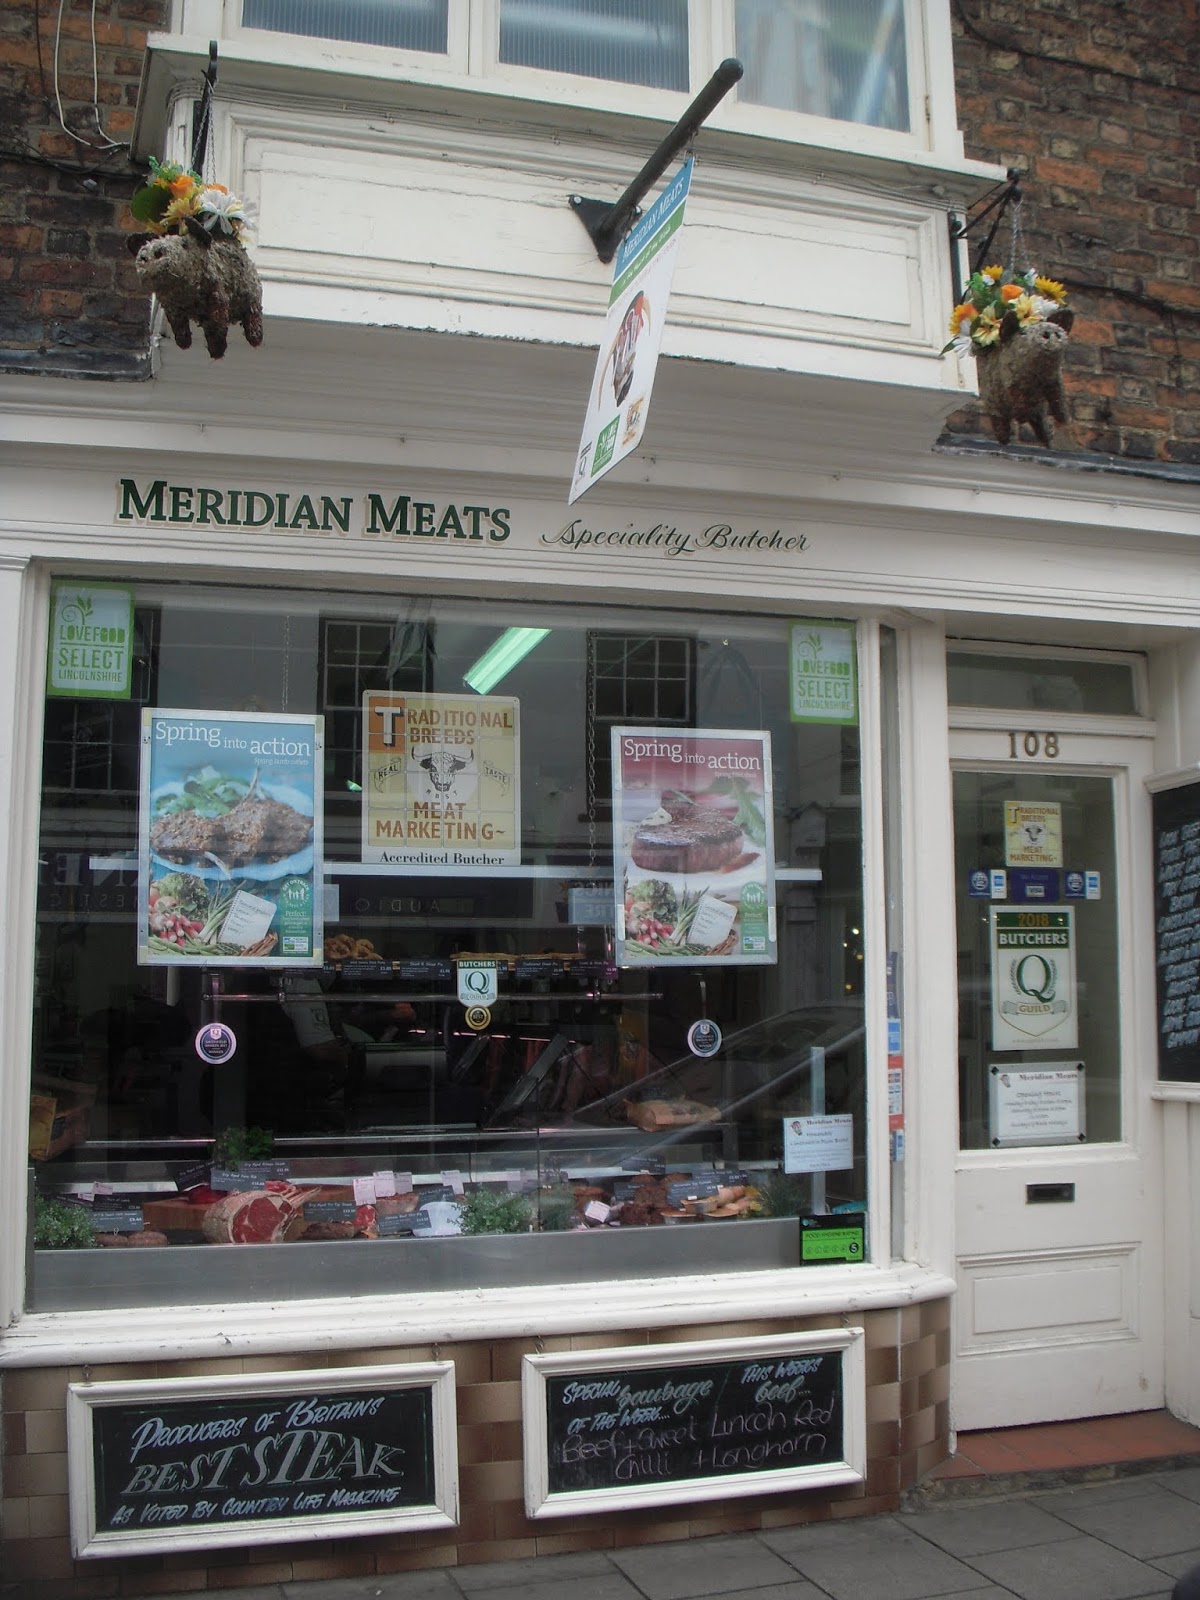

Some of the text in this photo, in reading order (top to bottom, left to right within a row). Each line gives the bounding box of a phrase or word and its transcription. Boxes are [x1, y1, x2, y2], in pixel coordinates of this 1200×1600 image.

[659, 177, 685, 219] MEATS
[118, 478, 511, 542] MERIDIAN MEATS
[541, 519, 811, 556] Speciality Butcher
[59, 648, 123, 669] SELECT
[58, 670, 122, 682] LINCOLNSHIRE
[798, 680, 850, 699] SELECT
[155, 722, 311, 757] Spring into action
[374, 706, 513, 747] TRADITIONAL
[410, 727, 475, 745] BREEDS
[624, 738, 761, 771] Spring into action
[1008, 732, 1059, 758] 108
[378, 766, 398, 780] REAL
[413, 801, 467, 820] MEAT
[380, 851, 505, 866] Accredited Butcher
[1018, 913, 1049, 927] 2018
[999, 933, 1068, 944] BUTCHERS
[468, 970, 490, 994] Q
[1016, 954, 1056, 1003] Q
[1019, 1004, 1051, 1013] GUILD
[741, 1358, 823, 1384] THIS WEEKS
[563, 1380, 621, 1405] SPECIAL
[794, 1391, 835, 1427] Red
[130, 1396, 385, 1463] PRODUCERS OF BRITAINS
[568, 1417, 591, 1435] OF
[590, 1412, 618, 1431] THE
[121, 1429, 406, 1495] BEST STEAK
[712, 1433, 827, 1469] Longhorn
[615, 1452, 672, 1480] Chilli
[111, 1487, 401, 1525] AS VOTED BY COUNTRY LIFE MAGAZINE
